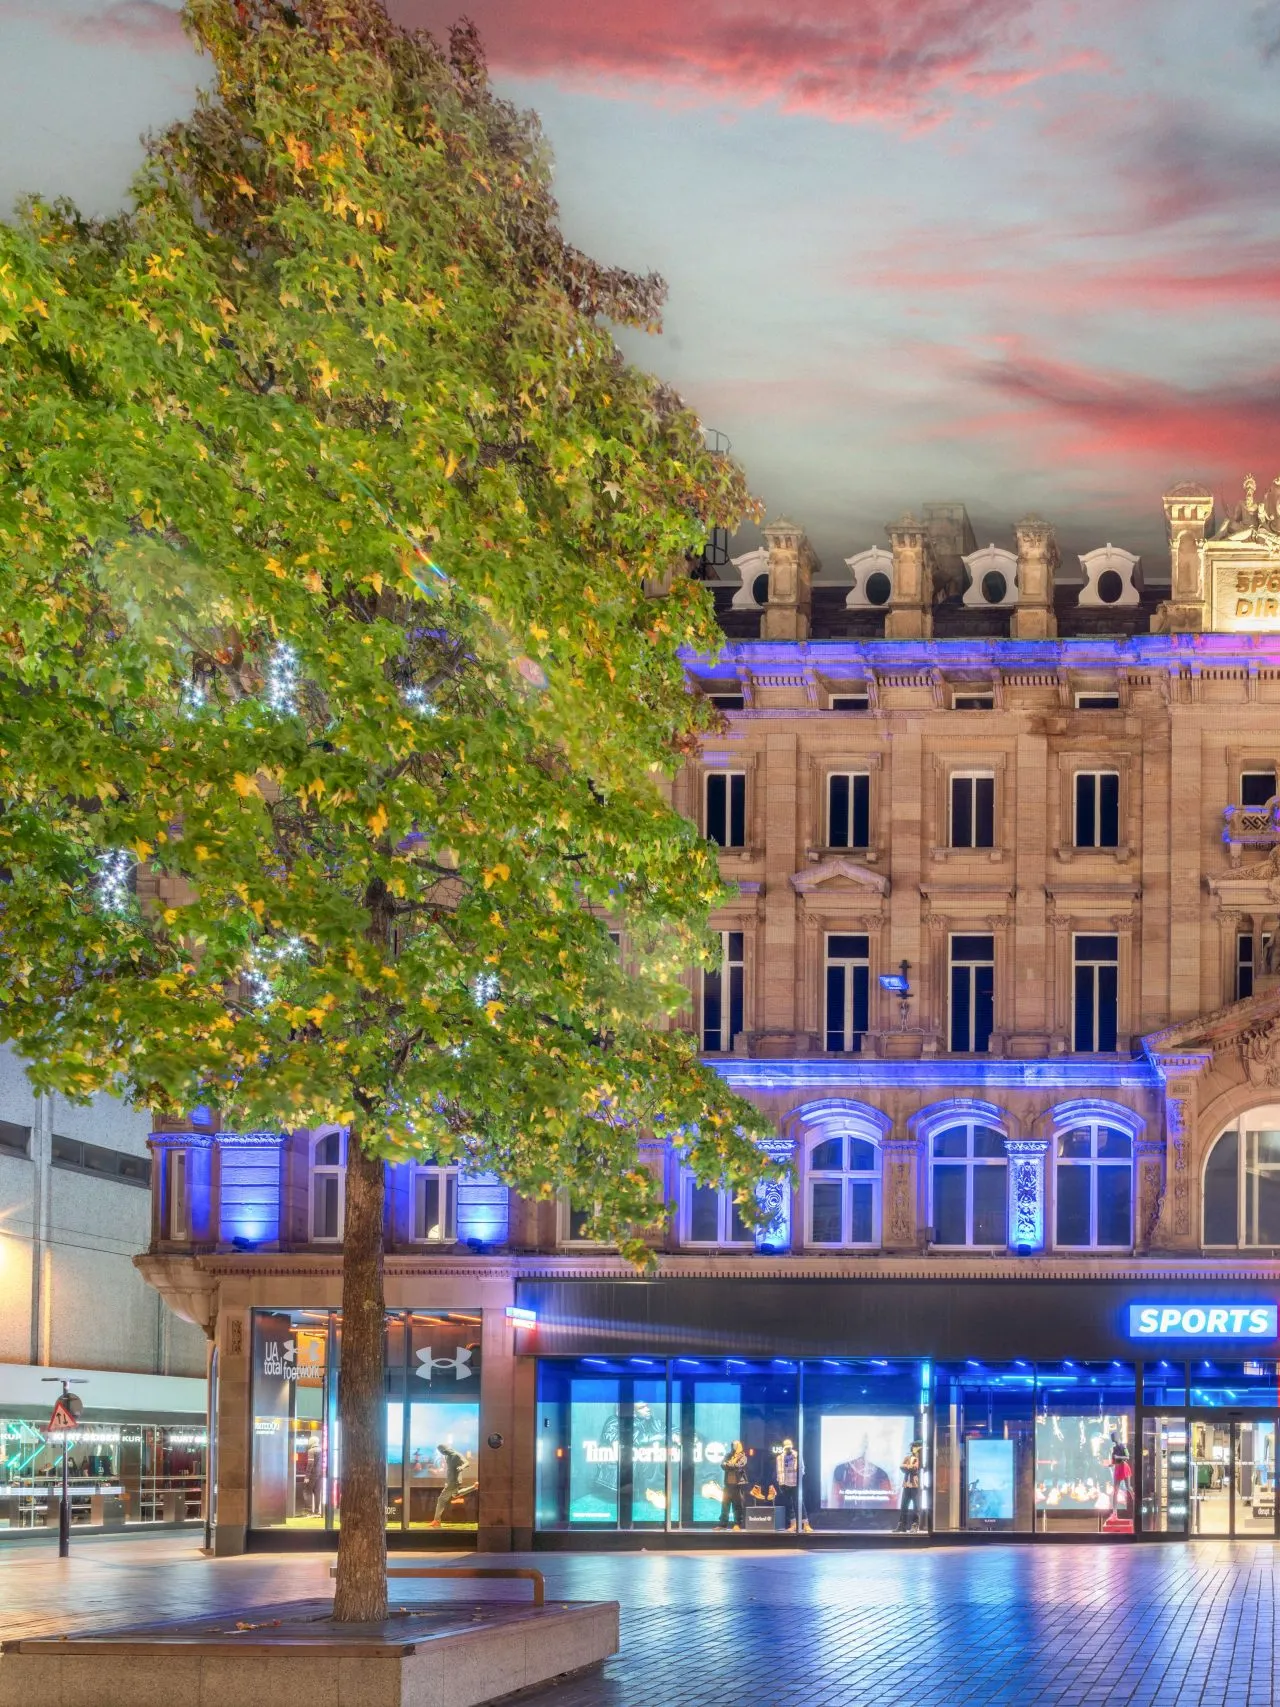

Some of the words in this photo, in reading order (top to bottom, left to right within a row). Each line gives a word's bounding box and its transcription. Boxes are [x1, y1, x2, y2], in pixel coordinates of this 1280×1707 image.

[1138, 1308, 1269, 1334] SPORTS
[265, 1342, 279, 1360] UA
[264, 1358, 282, 1375] total
